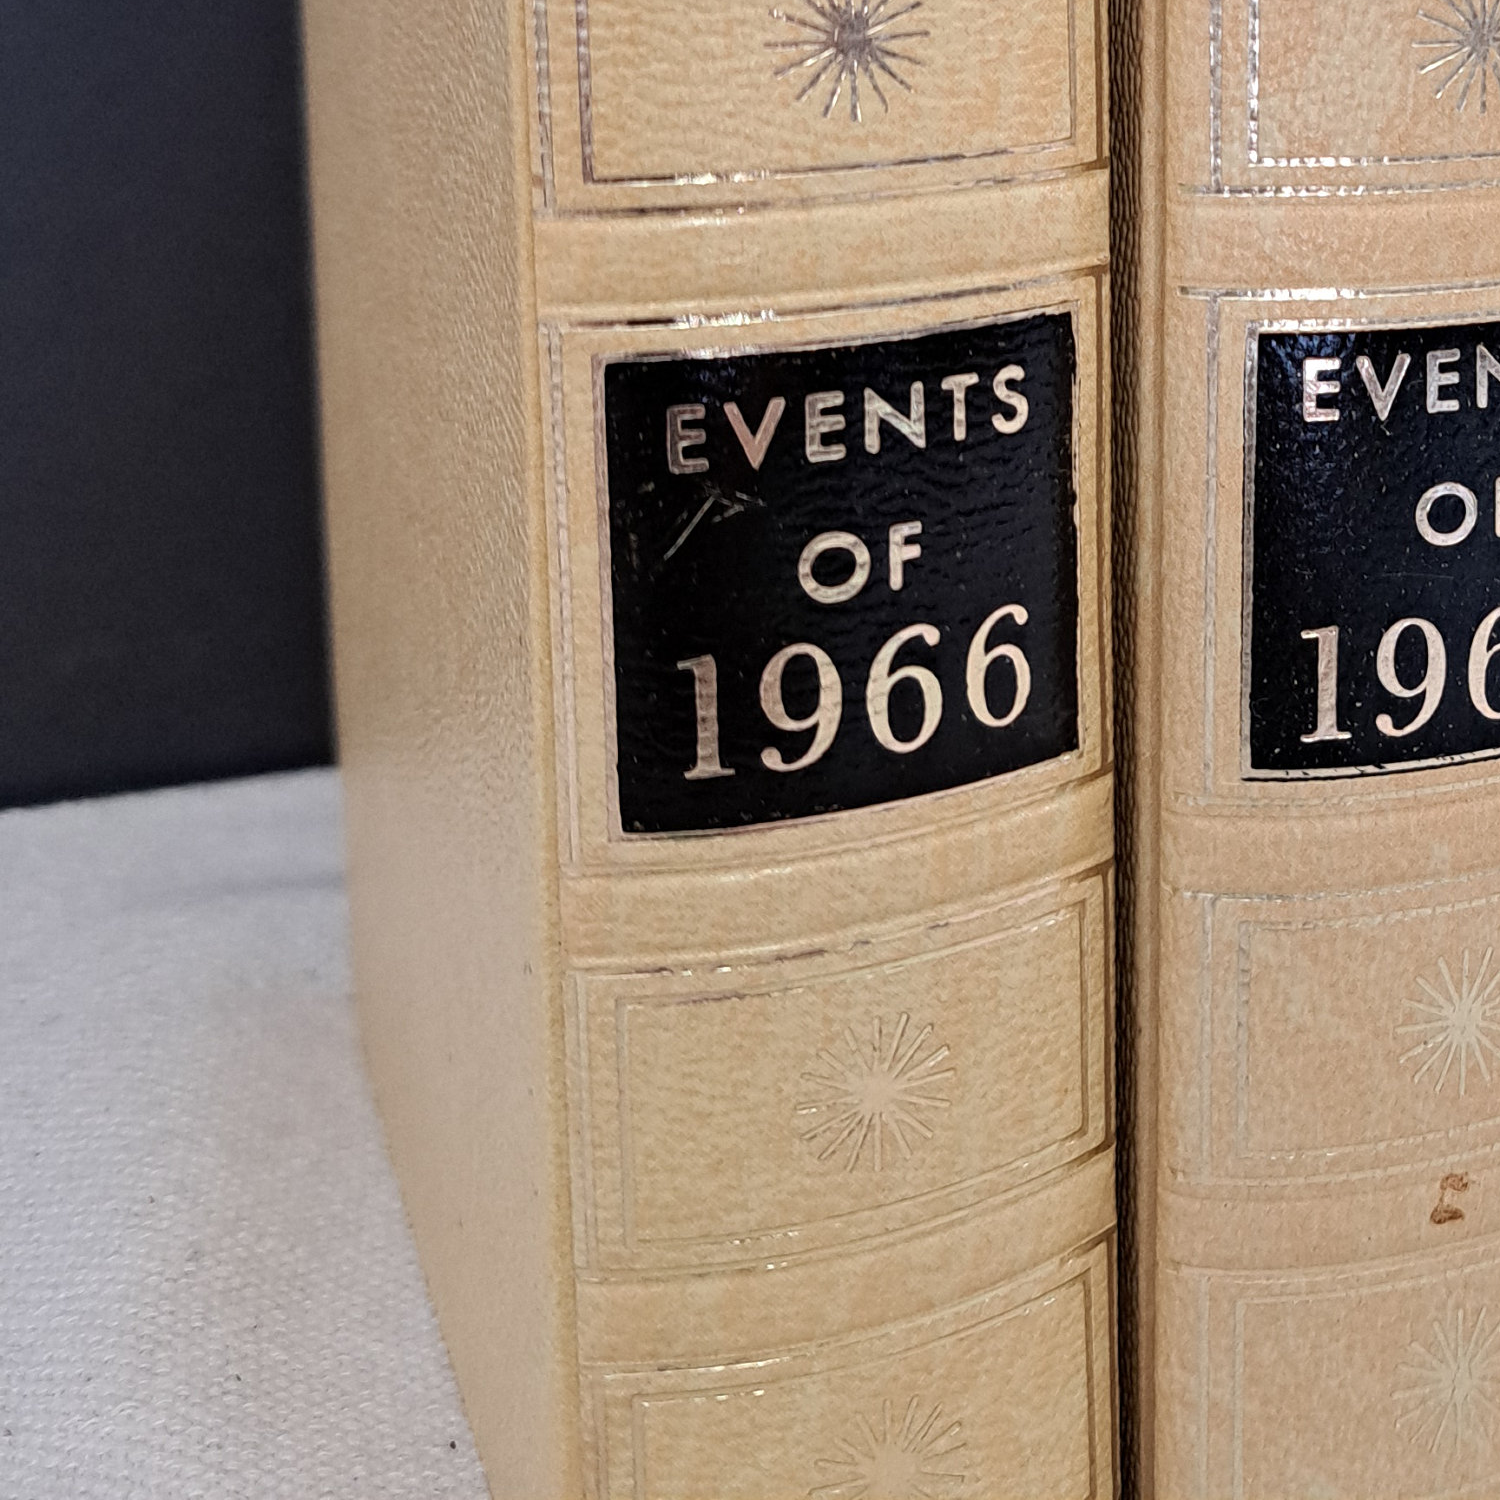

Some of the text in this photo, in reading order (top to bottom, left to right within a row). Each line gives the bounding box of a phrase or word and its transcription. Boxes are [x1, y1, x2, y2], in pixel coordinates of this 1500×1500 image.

[666, 364, 1029, 475] EVENTS
[798, 521, 922, 604] OF
[677, 603, 1031, 780] 1966
